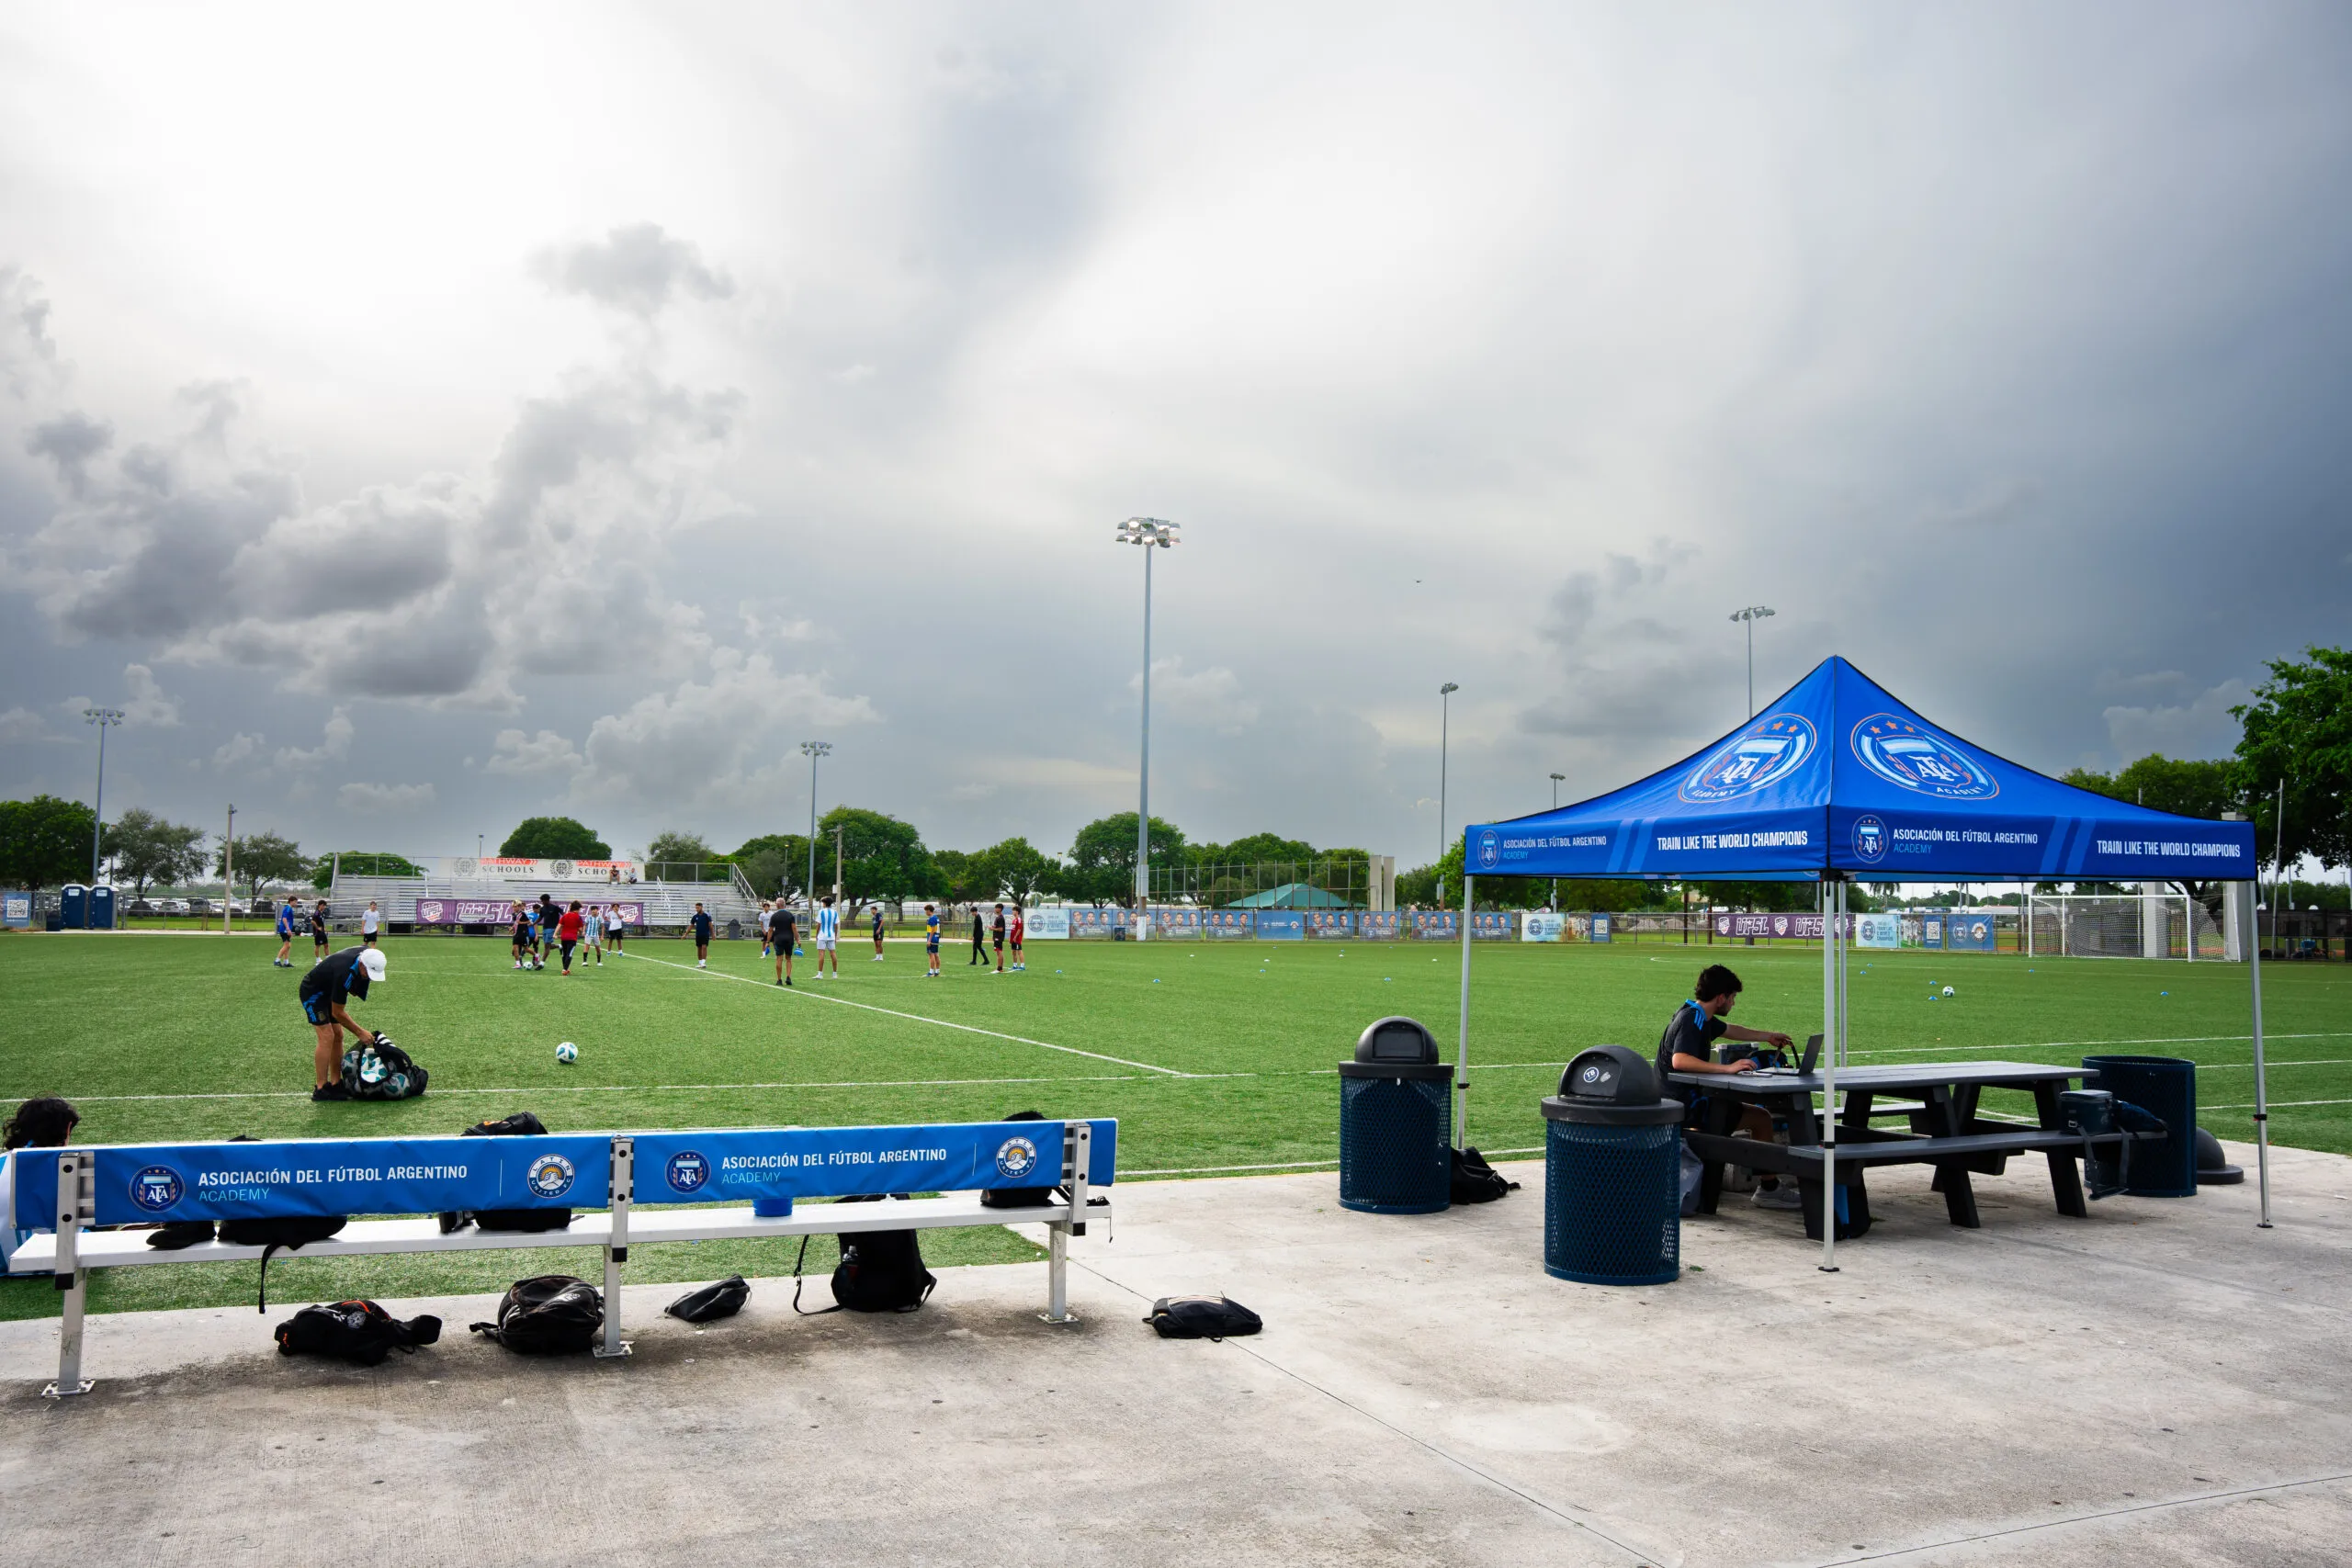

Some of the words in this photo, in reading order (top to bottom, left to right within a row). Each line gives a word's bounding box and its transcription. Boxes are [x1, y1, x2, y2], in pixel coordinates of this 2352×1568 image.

[1906, 754, 1961, 782] AFA
[1937, 785, 1984, 795] ACADEMY
[1503, 837, 1536, 849] ASOCIACIÓN
[1537, 838, 1548, 848] DEL
[1549, 835, 1571, 847] FÚTBOL
[1572, 835, 1607, 847] ARGENTINO
[1657, 837, 1681, 851] TRAIN
[1683, 836, 1700, 850] LIKE
[1702, 835, 1717, 850] THE
[1718, 833, 1750, 849] WORLD
[1751, 830, 1808, 847] CHAMPIONS
[1893, 828, 1943, 841] ASOCIACIÓN
[1945, 830, 1961, 842] DEL
[1962, 829, 1992, 843] FÚTBOL
[1994, 832, 2038, 844] ARGENTINO
[1503, 851, 1529, 860] ACADEMY
[1893, 843, 1932, 854] ACADEMY
[2097, 840, 2122, 854] TRAIN
[2124, 840, 2142, 855] LIKE
[2143, 841, 2159, 855] THE
[2160, 842, 2190, 856] WORLD
[2191, 843, 2241, 858] CHAMPIONS
[482, 865, 534, 874] SCHOOLS
[578, 867, 628, 875] SCHOS
[1736, 917, 1770, 936] UPSL
[1794, 917, 1825, 936] UPS
[1001, 1139, 1033, 1153] LATIN
[533, 1156, 571, 1171] LATIN
[721, 1152, 798, 1170] ASOCIACIÓN
[803, 1153, 824, 1167] DEL
[829, 1150, 875, 1166] FÚTBOL
[878, 1148, 946, 1163] ARGENTINO
[198, 1168, 290, 1187] ASOCIACIÓN
[296, 1169, 322, 1184] DEL
[327, 1166, 382, 1183] FÚTBOL
[387, 1165, 468, 1180] ARGENTINO
[721, 1171, 781, 1184] ACADEMY
[198, 1187, 270, 1202] ACADEMY
